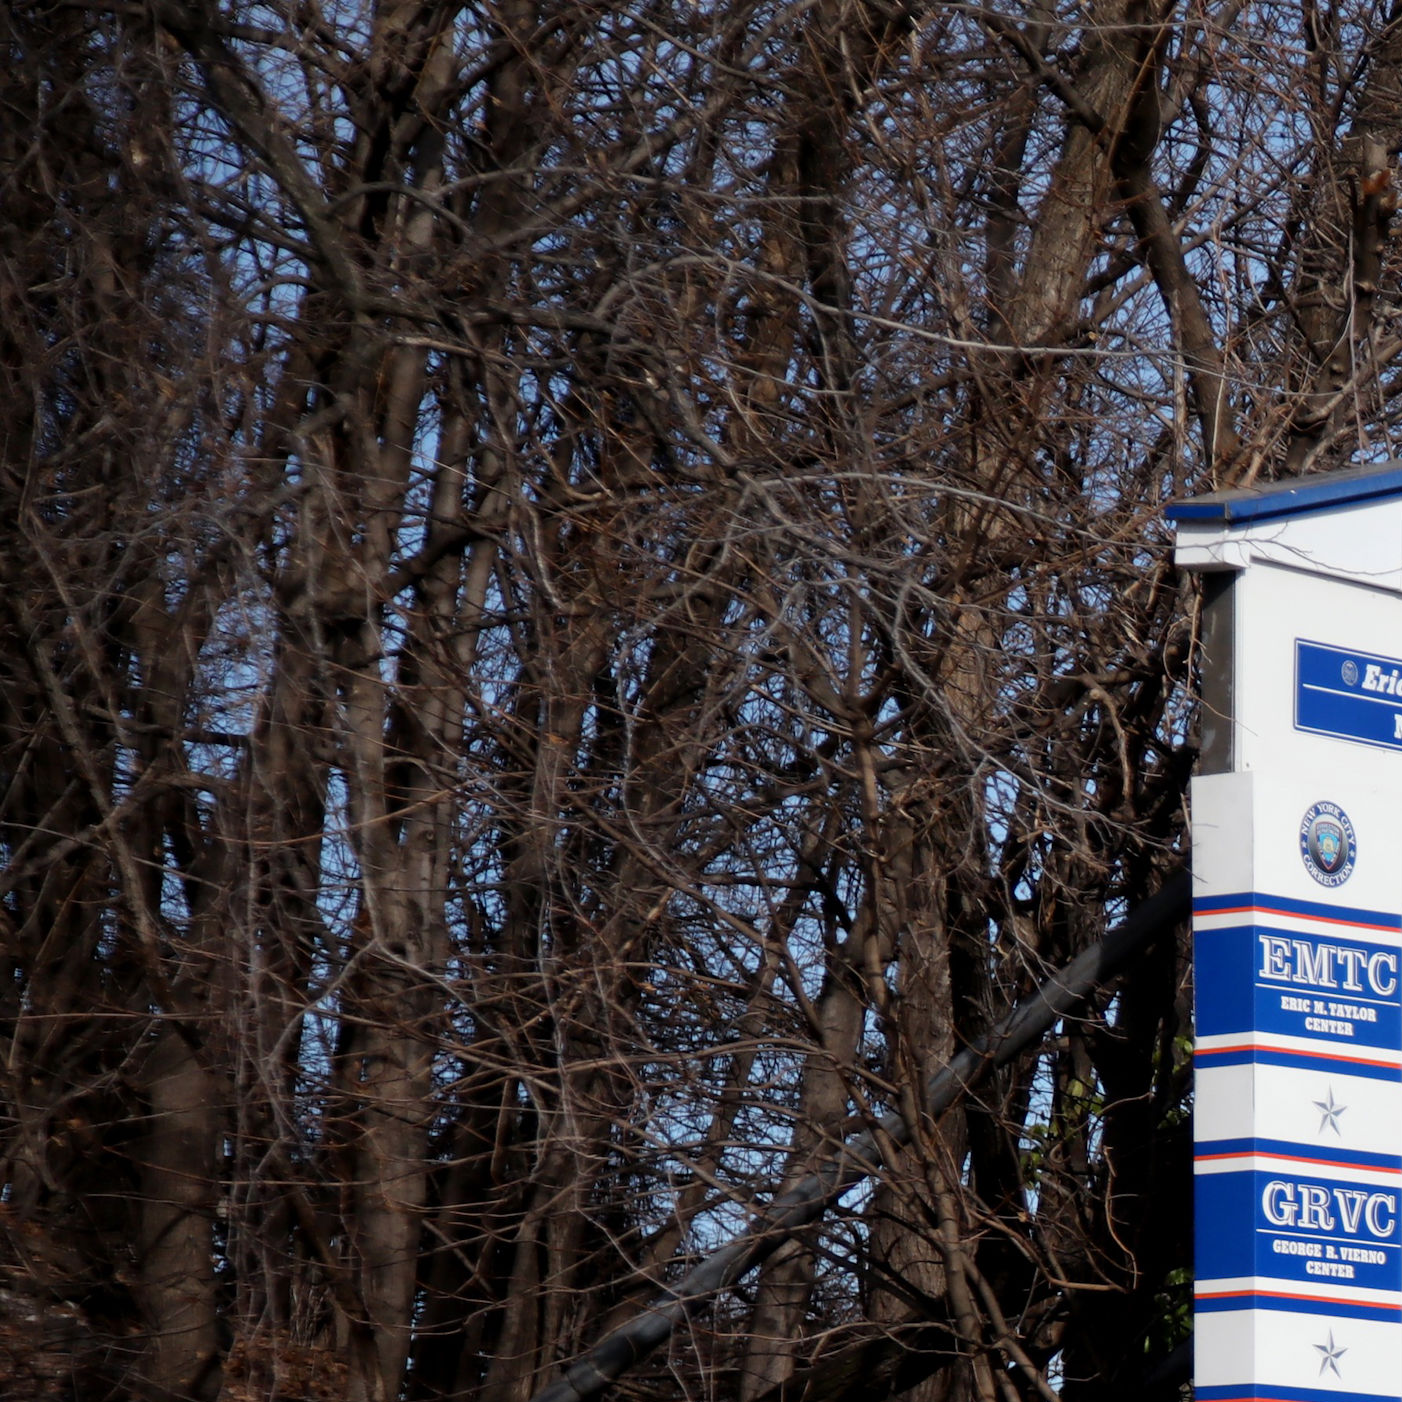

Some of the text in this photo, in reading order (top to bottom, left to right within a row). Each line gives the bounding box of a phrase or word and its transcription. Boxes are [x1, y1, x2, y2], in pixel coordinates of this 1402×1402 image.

[1301, 807, 1318, 836] NEW
[1316, 802, 1342, 817] YORK
[1341, 815, 1356, 846] CITY
[1303, 854, 1353, 887] CORRECTION
[1258, 933, 1397, 997] EMTC
[1281, 995, 1377, 1023] ERIC M. TAYLOR
[1304, 1016, 1355, 1037] CENTER
[1262, 1180, 1396, 1238] GRVC
[1273, 1239, 1386, 1265] GEORGE R. VIERNO
[1305, 1260, 1355, 1279] CENTER
